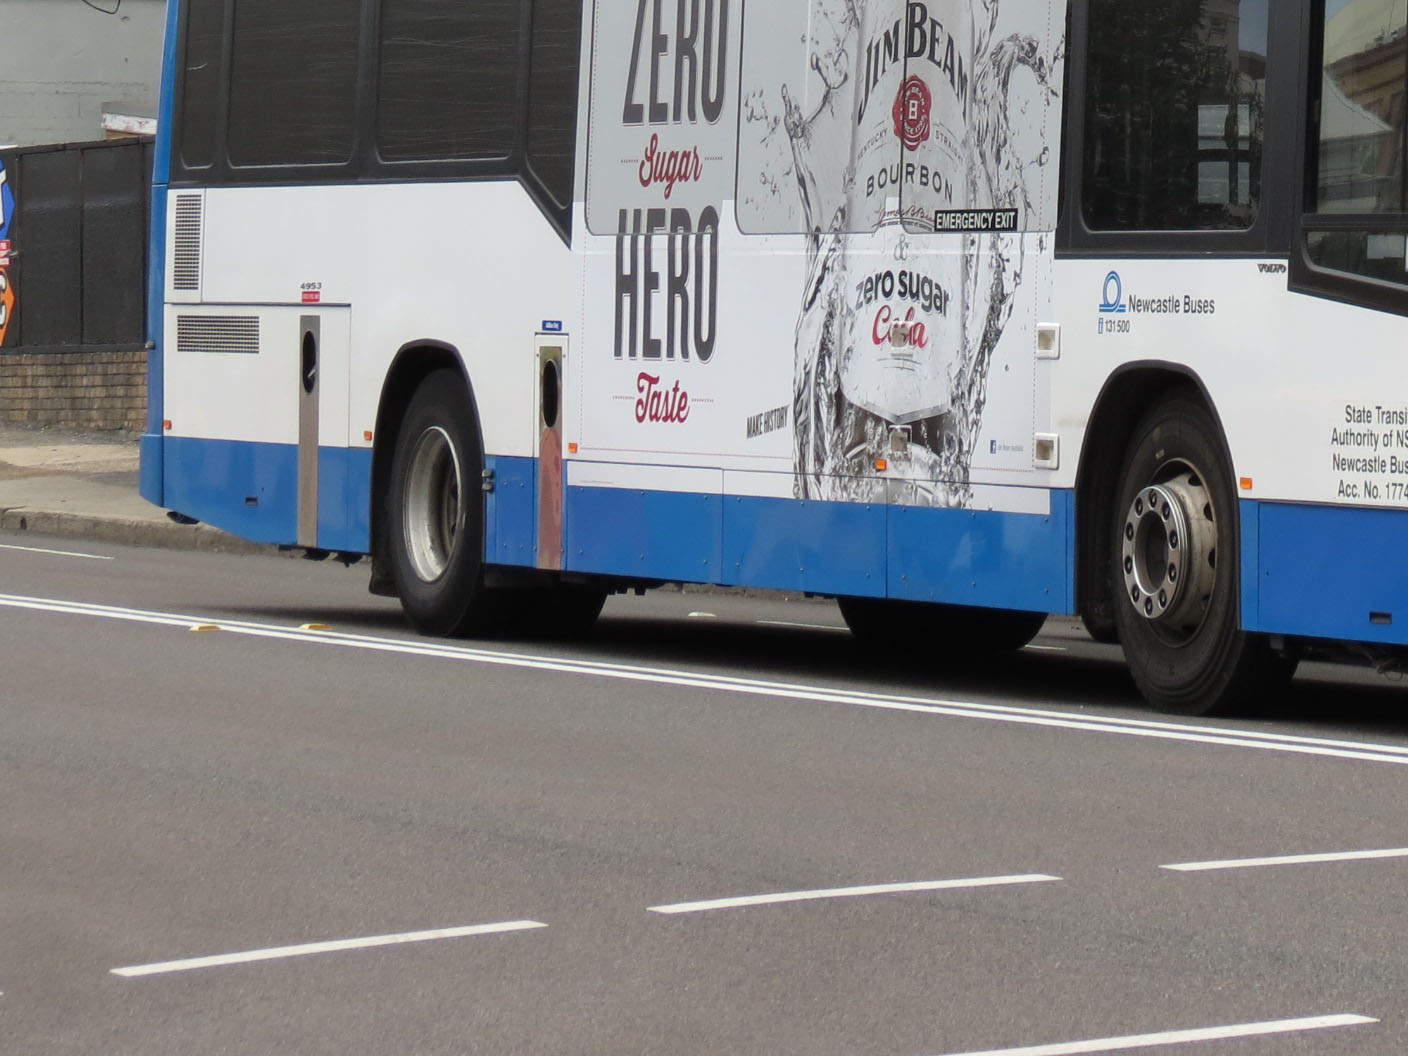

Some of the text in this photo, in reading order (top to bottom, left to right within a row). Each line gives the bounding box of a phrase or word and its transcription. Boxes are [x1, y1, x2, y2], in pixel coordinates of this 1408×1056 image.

[858, 1, 970, 128] JIM BEAM
[908, 100, 918, 120] B
[639, 132, 703, 200] Sugar
[866, 162, 953, 205] BOURBON
[936, 212, 994, 230] EMERGENCY
[994, 211, 1016, 230] EXIT
[1257, 263, 1287, 273] VOLVO
[300, 282, 322, 290] 4953
[613, 205, 719, 363] HERO
[856, 269, 950, 318] zero sugar
[1128, 294, 1216, 314] Newcastle Buses
[635, 371, 691, 424] Taste
[746, 404, 791, 439] MAKE HISTORY
[1345, 404, 1372, 424] State
[1331, 427, 1380, 452] Authority
[1382, 429, 1393, 447] of
[1332, 453, 1387, 473] Newcastle
[1338, 479, 1360, 498] Acc.
[1364, 480, 1381, 499] No.
